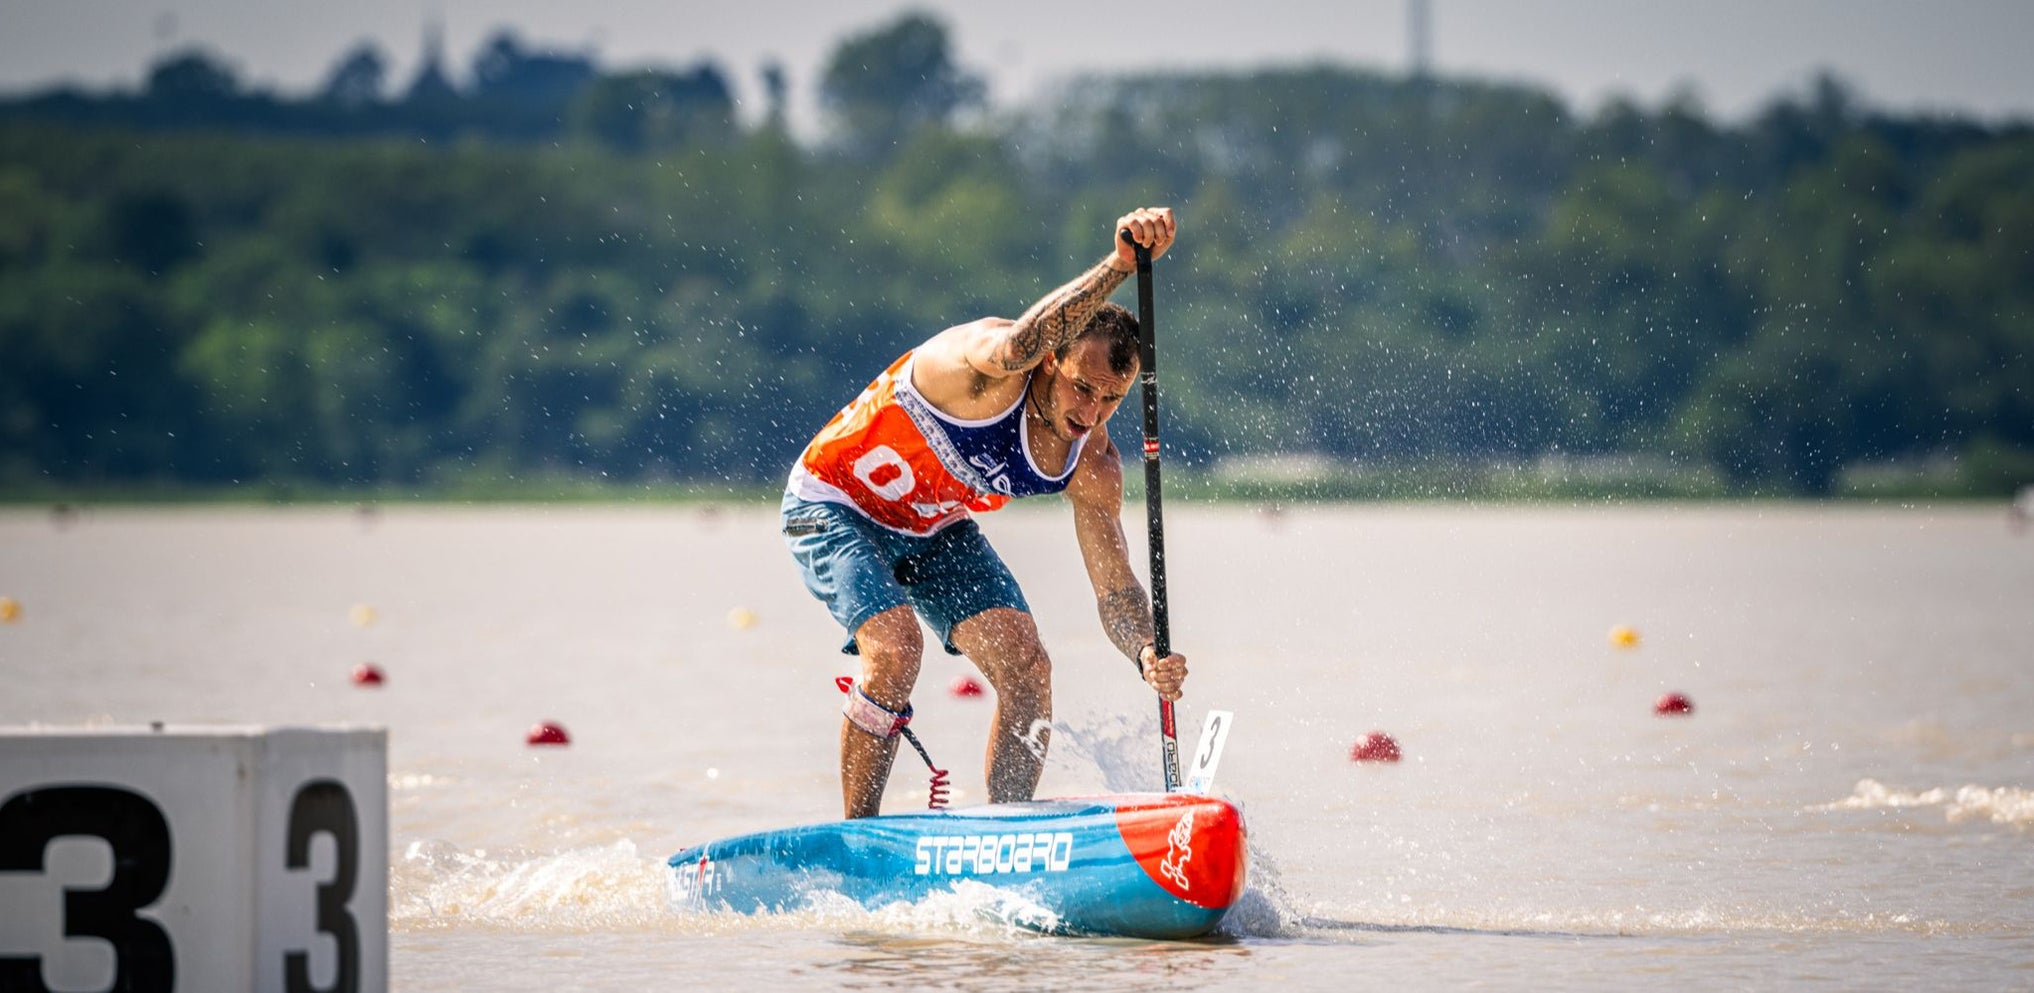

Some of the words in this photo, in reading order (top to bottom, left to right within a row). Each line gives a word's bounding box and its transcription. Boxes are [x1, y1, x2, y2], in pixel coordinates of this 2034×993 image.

[1200, 716, 1221, 769] 3
[0, 781, 175, 993] 3
[284, 777, 360, 993] 3
